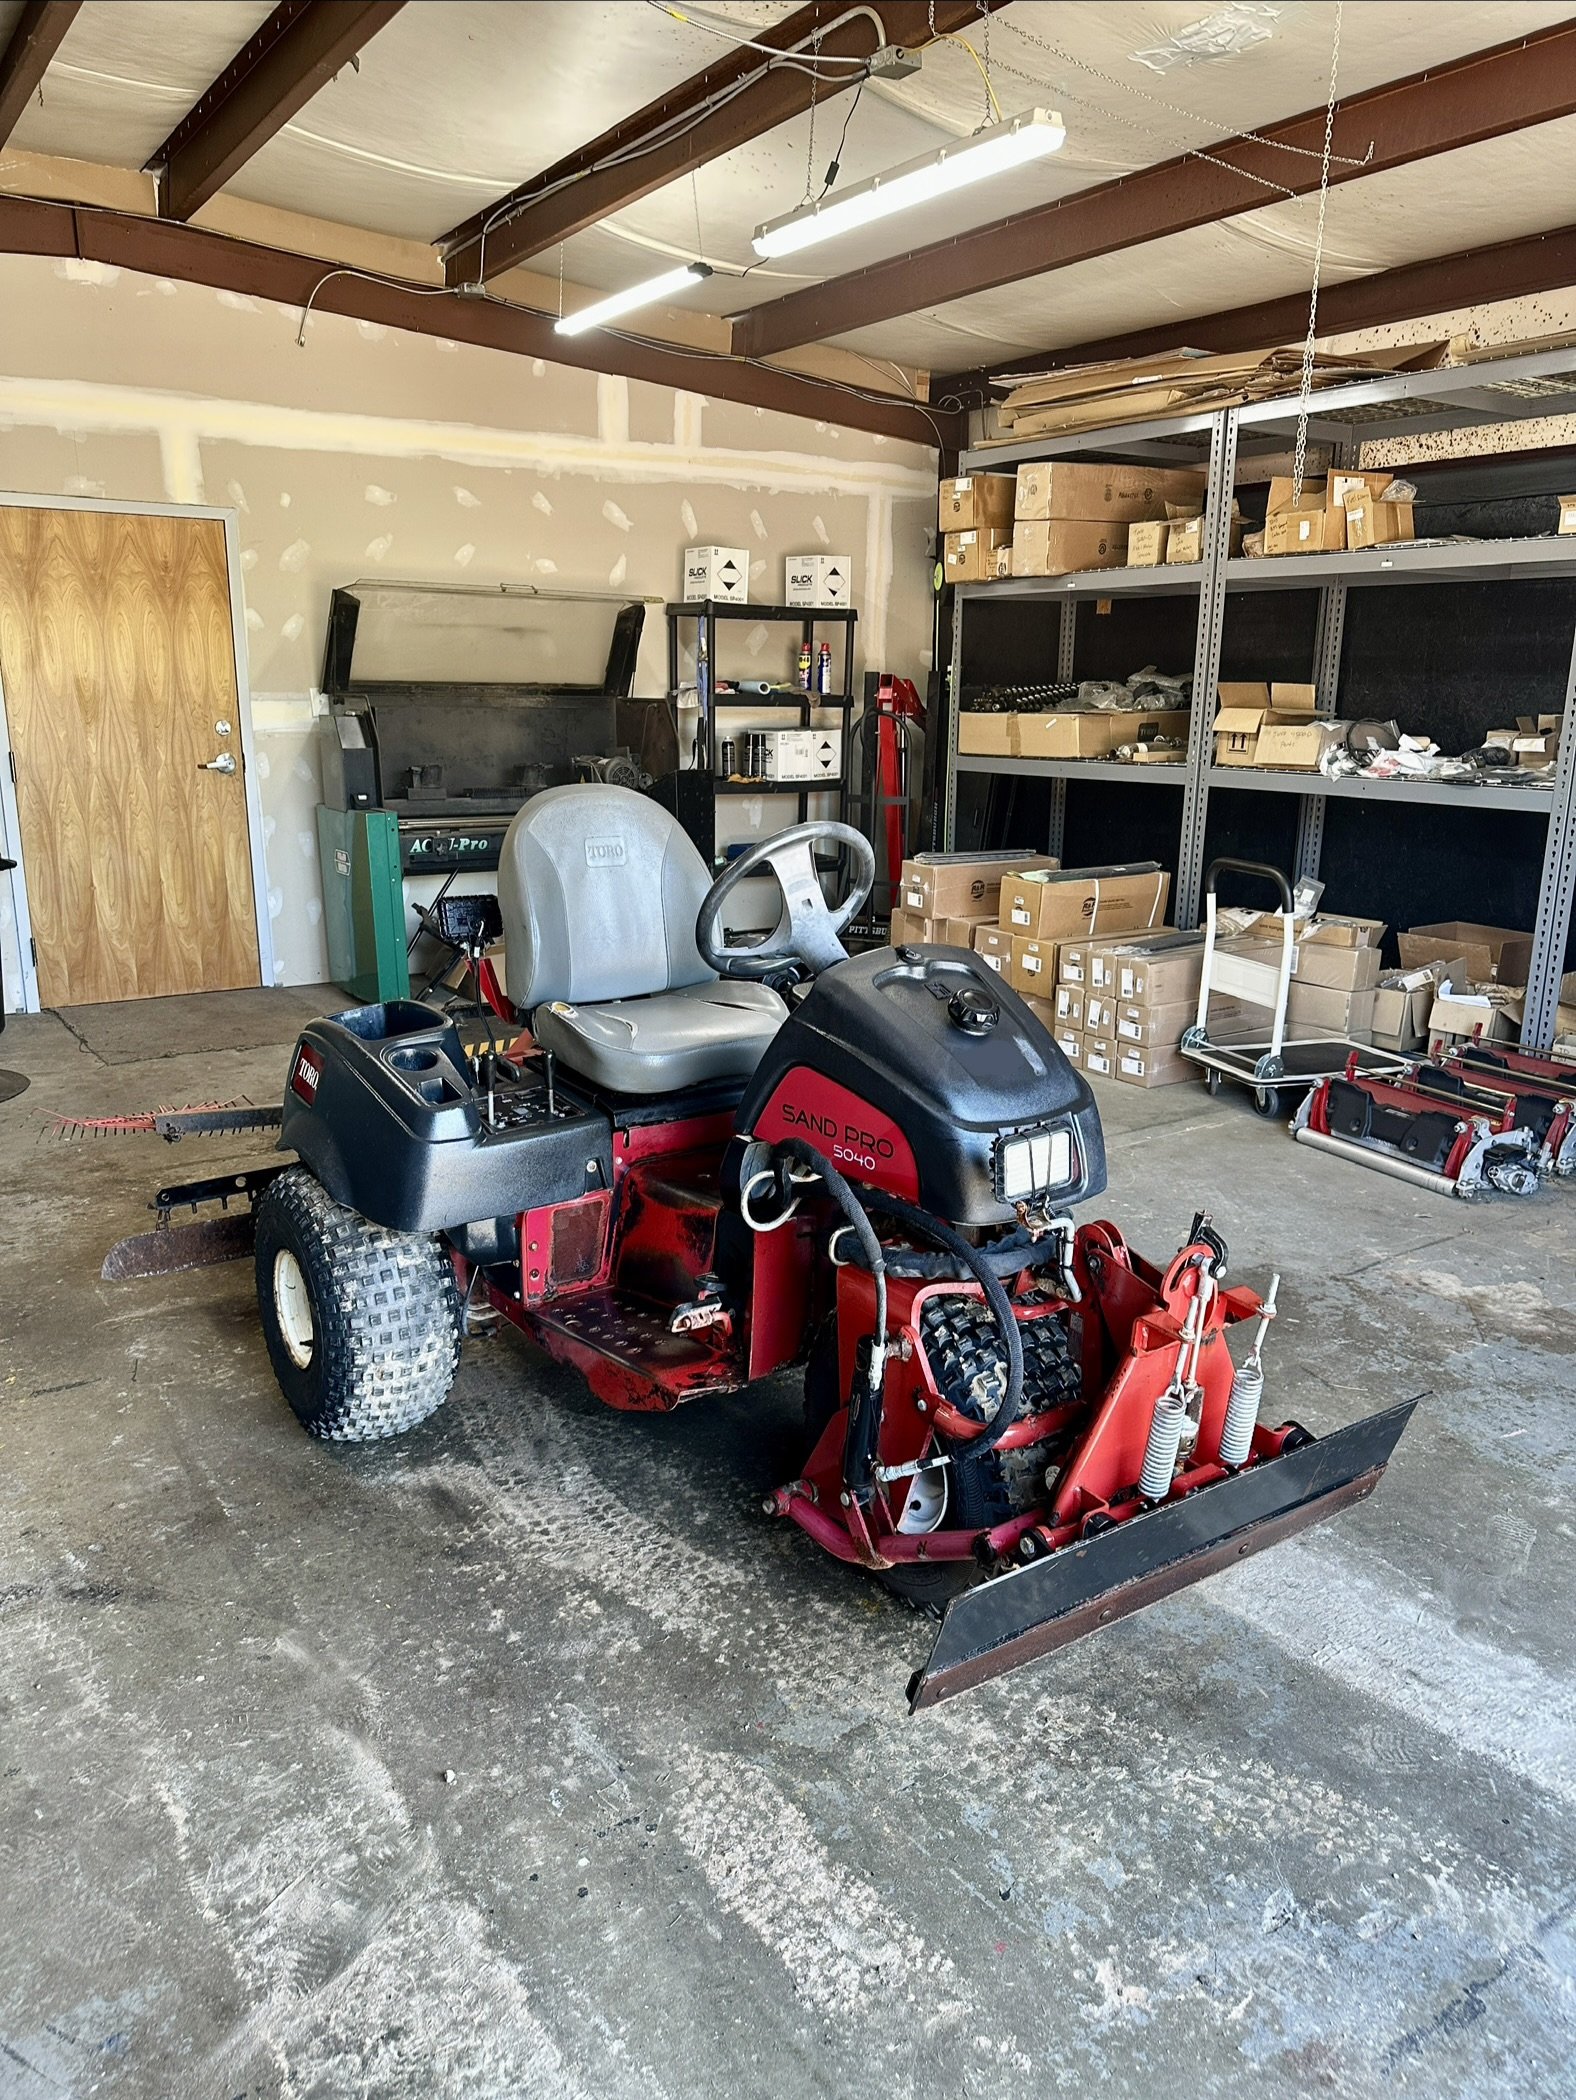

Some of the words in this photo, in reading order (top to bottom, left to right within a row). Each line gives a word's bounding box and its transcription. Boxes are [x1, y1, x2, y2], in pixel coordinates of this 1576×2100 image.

[688, 566, 707, 577] SLICK
[790, 574, 813, 584] SLICK
[713, 593, 729, 601] MODEL
[587, 844, 624, 858] TORO
[298, 1056, 319, 1090] TORO
[782, 1103, 838, 1138] SAND
[844, 1125, 894, 1158] PRO
[833, 1144, 876, 1170] 5040
